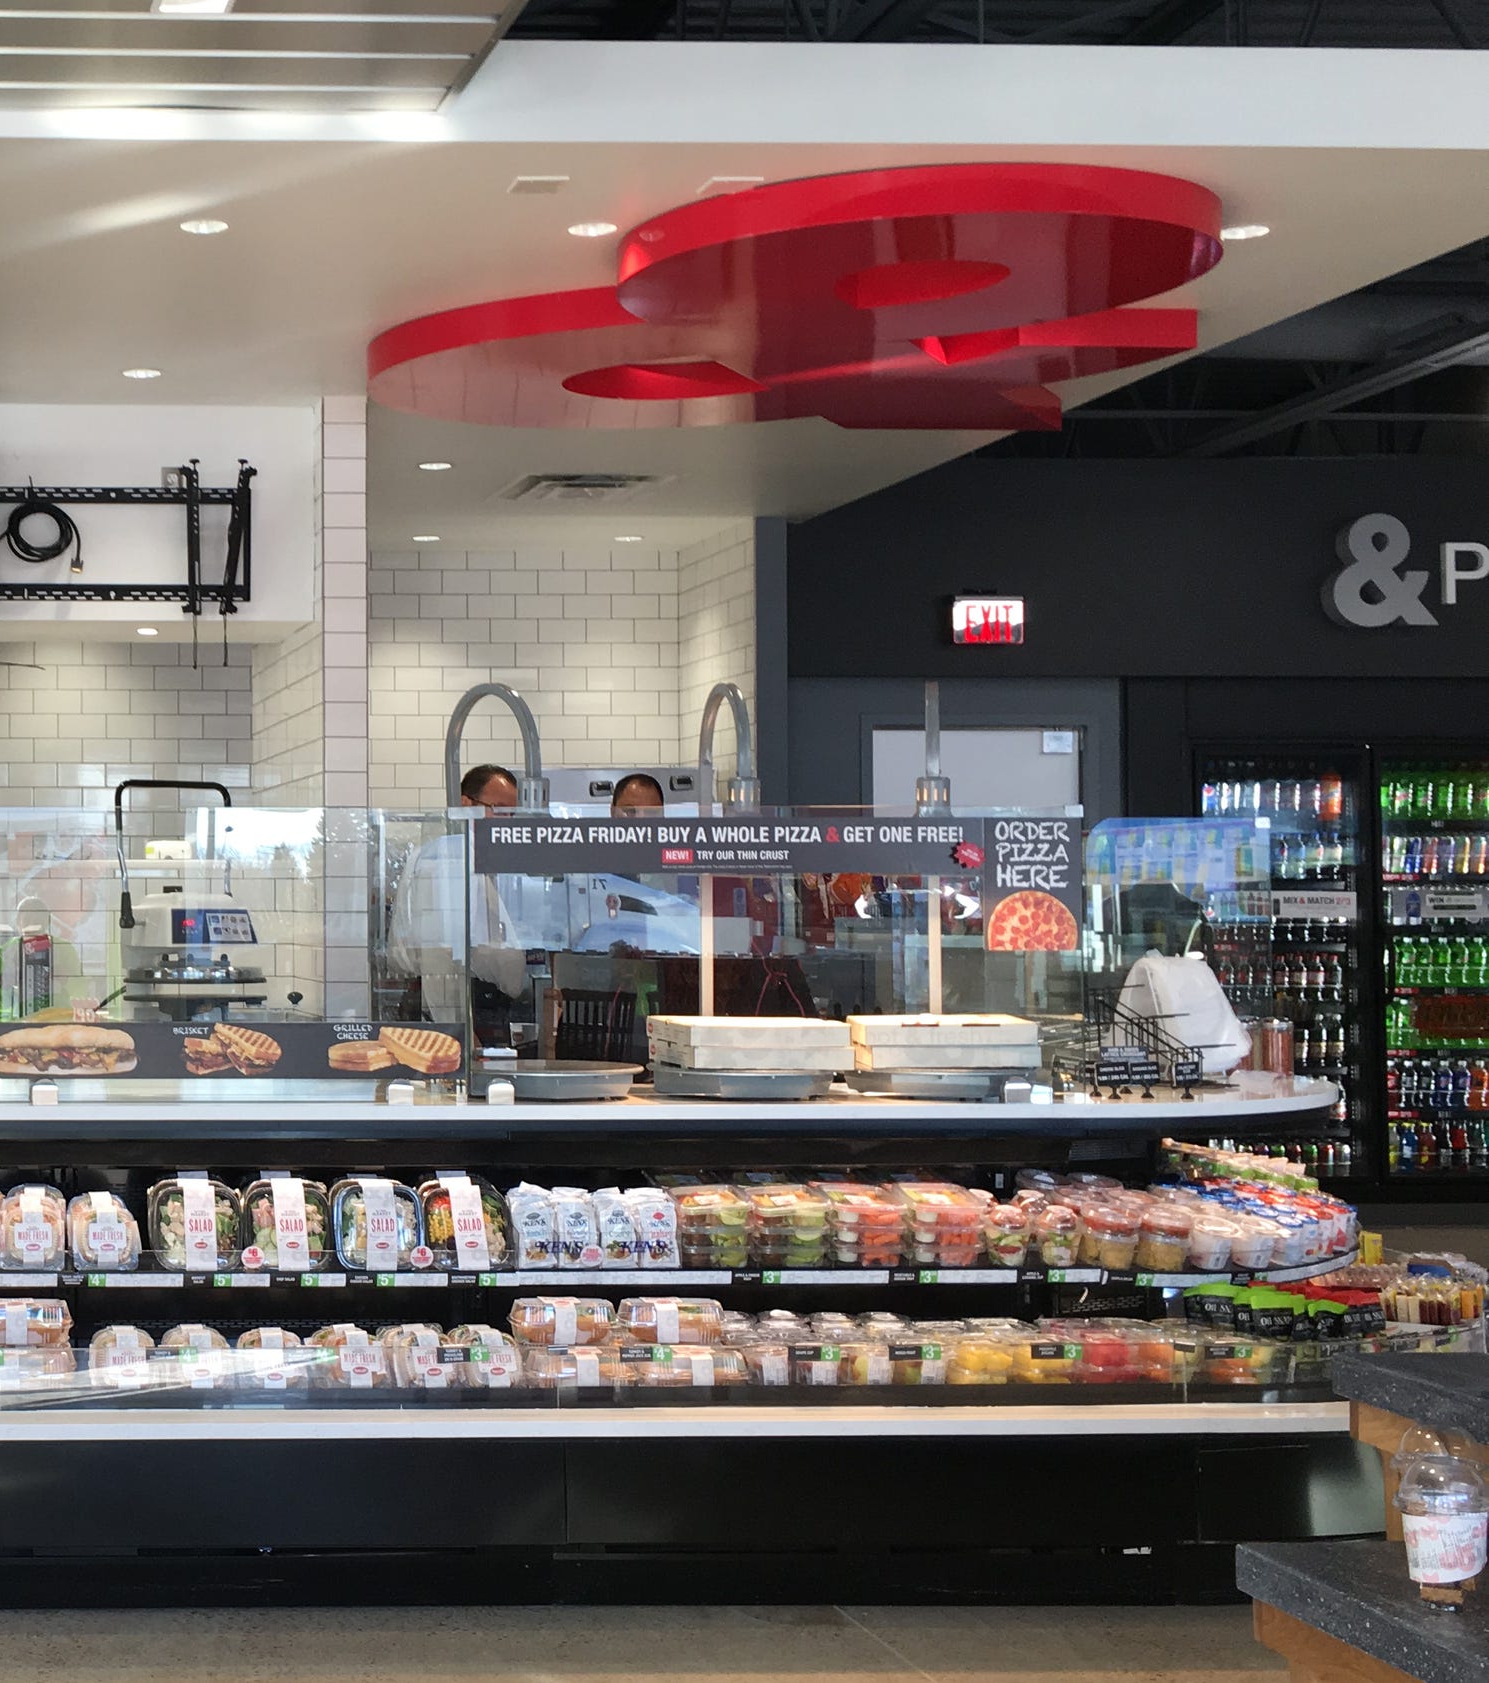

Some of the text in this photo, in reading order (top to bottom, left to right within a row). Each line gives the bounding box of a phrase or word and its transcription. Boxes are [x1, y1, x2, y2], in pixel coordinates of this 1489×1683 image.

[964, 605, 1013, 643] EXIT
[491, 826, 964, 844] FREE PIZZA FRIDAY! BUY A WHOLE PIZZA & GET ONE FREE!
[994, 821, 1070, 842] ORDER
[665, 851, 790, 860] NEW! TRY OUR THIN CRUST
[995, 843, 1069, 863] PIZZA
[996, 865, 1069, 889] HERE
[1283, 896, 1298, 904] MIX
[1307, 896, 1335, 904] MATCH
[172, 1027, 209, 1035] BRISKET
[333, 1024, 373, 1032] GRILLED
[336, 1032, 370, 1040] CHEESE
[189, 1218, 213, 1232] SALAD
[279, 1218, 304, 1232] SALAD
[371, 1218, 395, 1232] SALAD
[457, 1218, 482, 1232] SALAD
[18, 1231, 49, 1241] MADE FRESH
[92, 1231, 123, 1241] MADE FRESH
